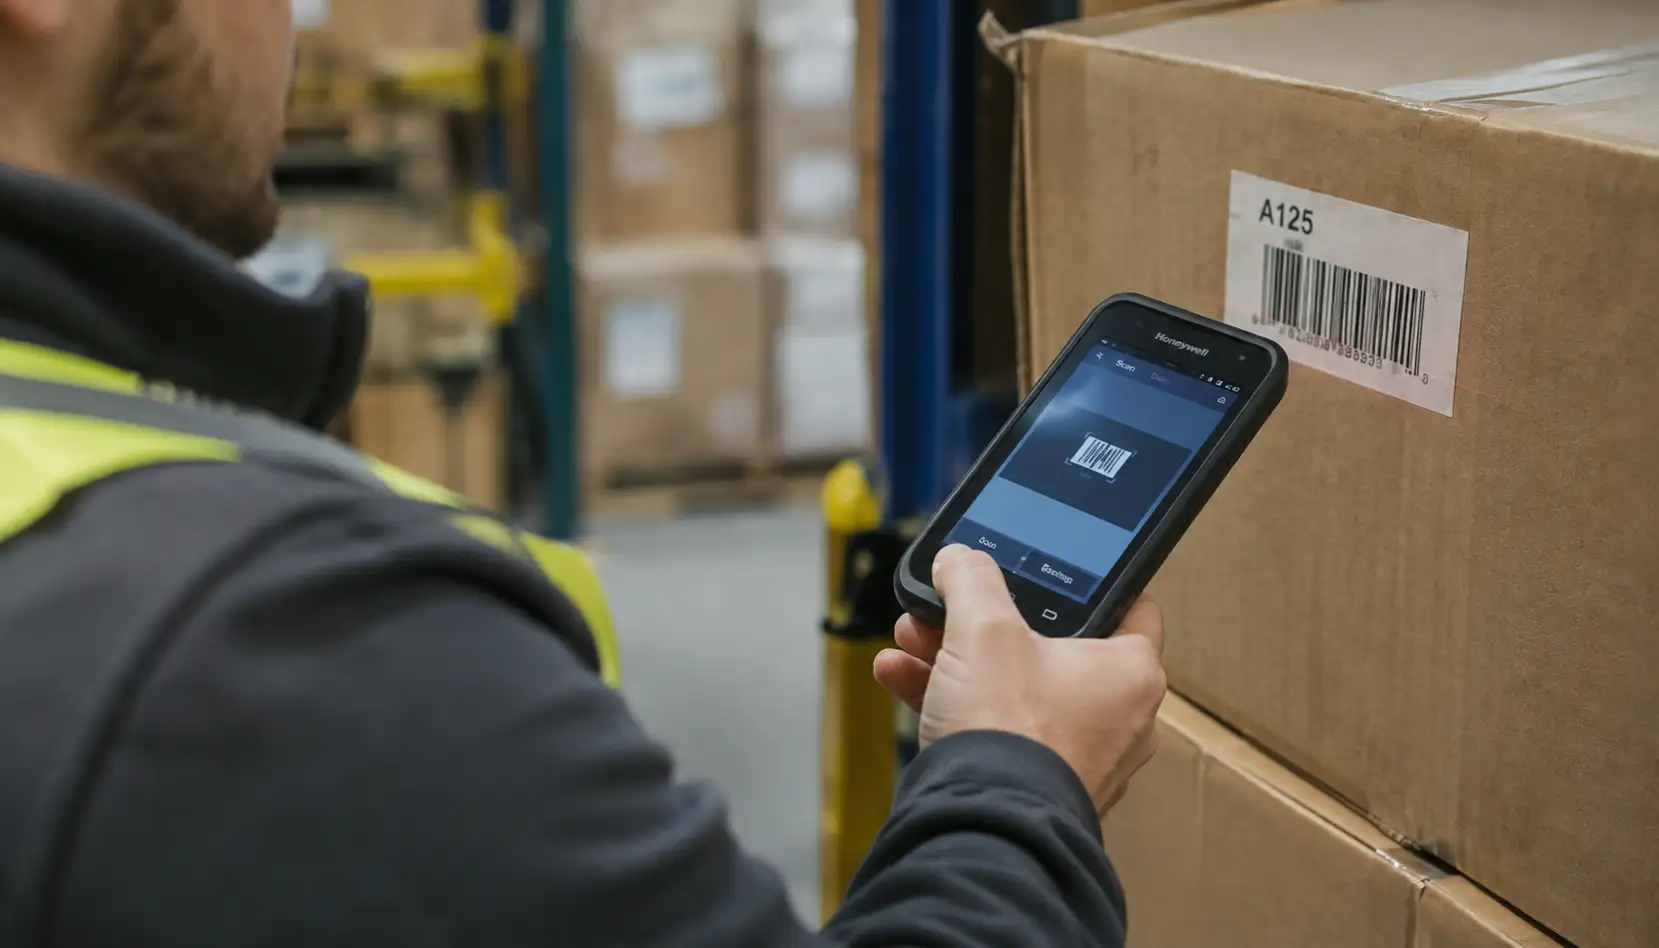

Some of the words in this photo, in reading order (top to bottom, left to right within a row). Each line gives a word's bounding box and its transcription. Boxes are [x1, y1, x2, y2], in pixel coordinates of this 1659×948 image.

[1259, 198, 1314, 235] A125
[1155, 332, 1209, 357] Honeywell
[1115, 359, 1136, 373] Scan
